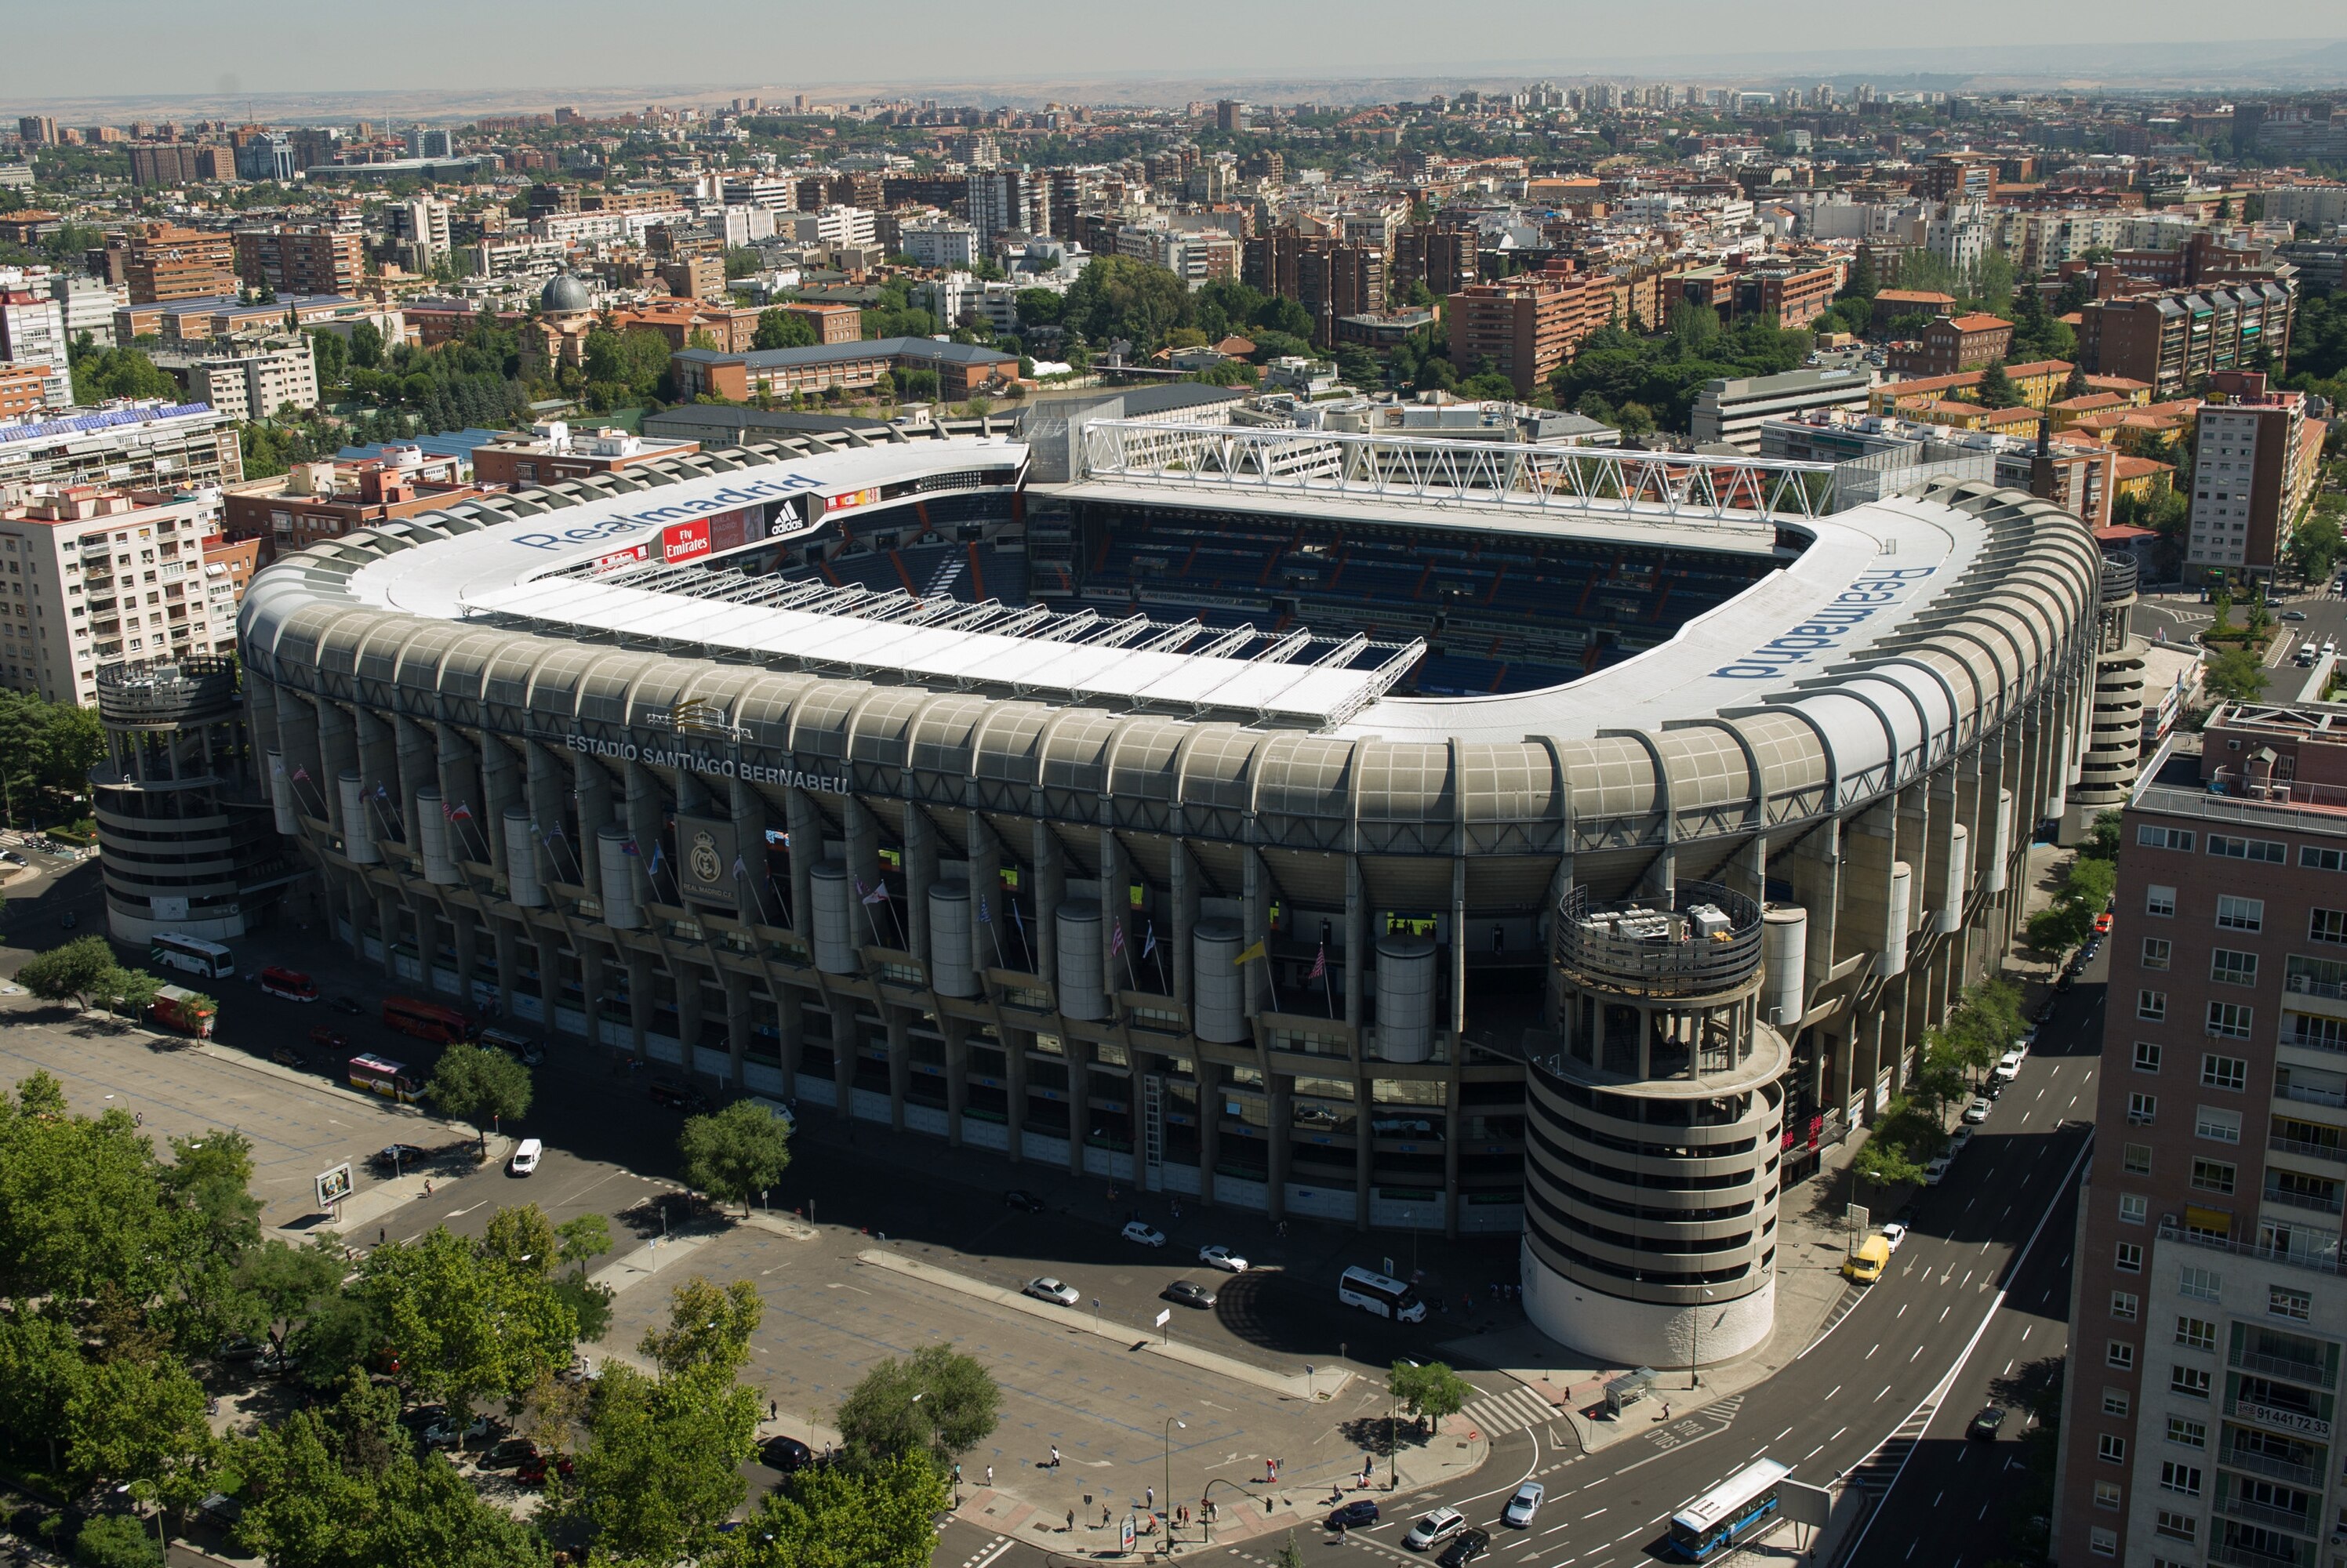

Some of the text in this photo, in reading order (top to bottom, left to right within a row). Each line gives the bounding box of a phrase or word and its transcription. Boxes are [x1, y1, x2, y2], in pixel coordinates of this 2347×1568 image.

[679, 529, 692, 540] Fly
[772, 517, 803, 535] adidas
[667, 538, 708, 558] Emirates
[566, 734, 848, 796] ESTADIO SANTIAGO BERNABEU
[683, 883, 698, 891] REAL
[699, 887, 721, 896] MADRID
[1673, 1419, 1705, 1437] BUS
[2257, 1407, 2270, 1420] 91
[2273, 1412, 2294, 1425] 441
[2297, 1417, 2311, 1429] 72
[2314, 1421, 2329, 1434] 33
[1644, 1428, 1681, 1449] SOLO
